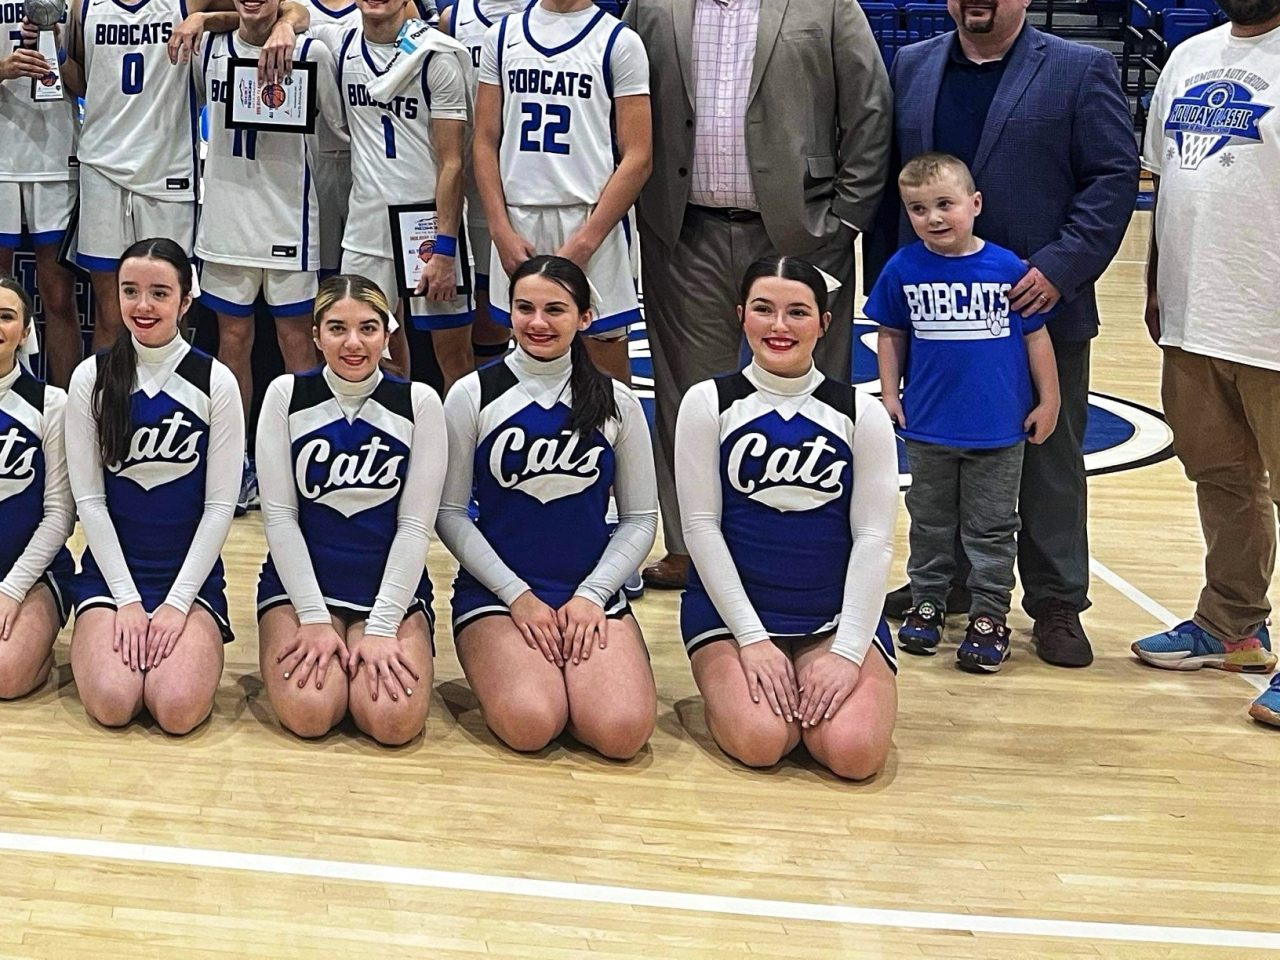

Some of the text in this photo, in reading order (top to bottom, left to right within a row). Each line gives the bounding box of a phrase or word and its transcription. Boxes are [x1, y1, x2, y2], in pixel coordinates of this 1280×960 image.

[95, 22, 173, 45] BOBCATS
[122, 53, 144, 95] 0
[508, 69, 593, 99] BOBCATS
[1185, 68, 1247, 88] REDMOND AUTO
[520, 102, 571, 155] 22
[1169, 104, 1214, 127] HOLIDAY
[381, 115, 397, 159] 1
[903, 282, 1013, 321] BOBCATS
[296, 436, 405, 510] Cats
[489, 427, 605, 496] Cats
[728, 432, 847, 504] Cats
